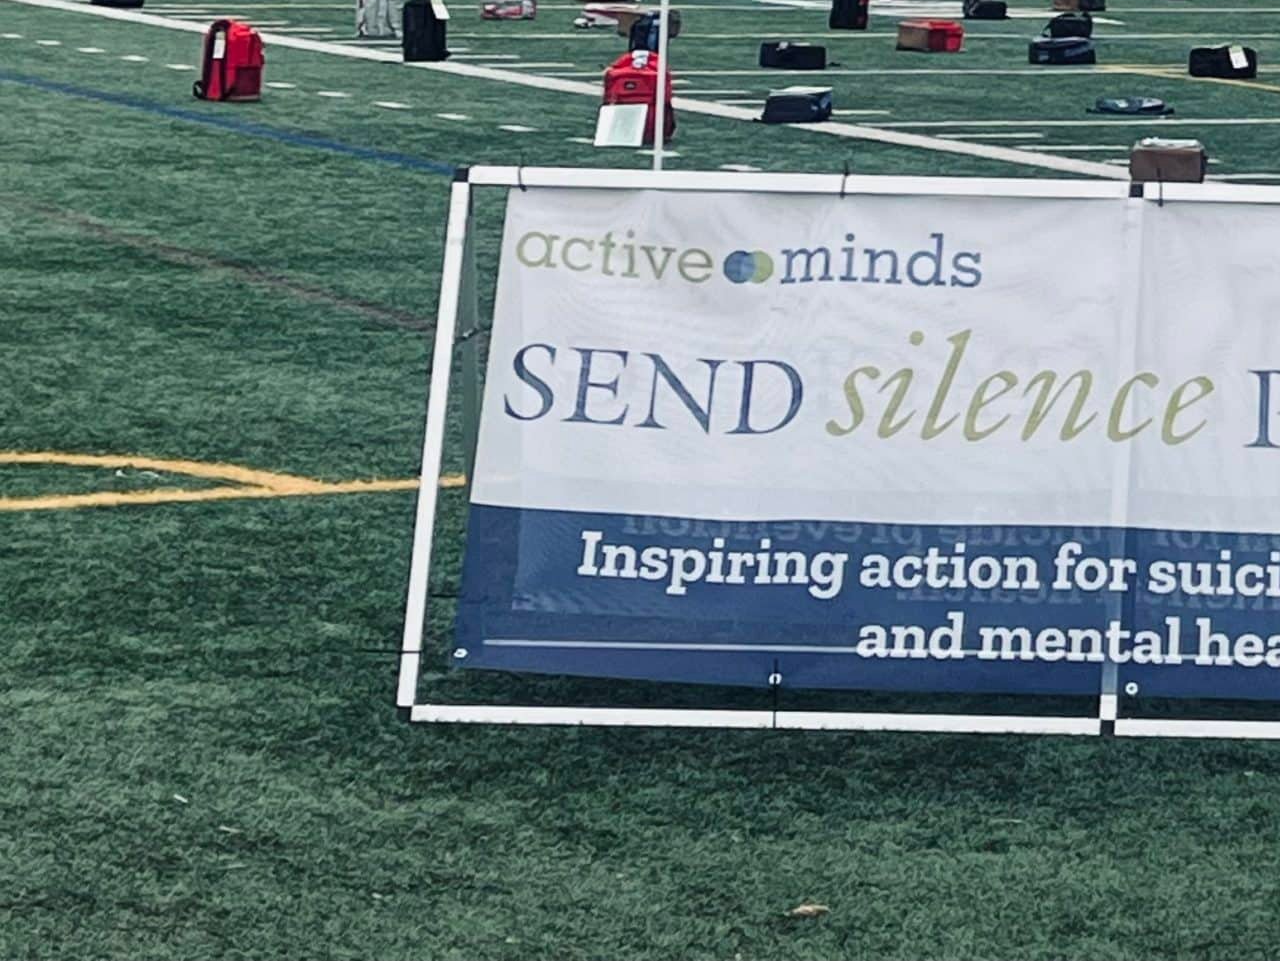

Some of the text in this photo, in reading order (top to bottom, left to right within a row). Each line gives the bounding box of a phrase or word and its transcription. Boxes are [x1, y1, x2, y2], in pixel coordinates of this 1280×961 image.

[516, 229, 983, 289] active minds
[503, 343, 804, 435] SEND
[825, 329, 1215, 445] silence
[577, 530, 849, 598] Inspiring
[859, 543, 1040, 591] action
[1053, 541, 1137, 592] for
[856, 611, 965, 659] and
[977, 616, 1182, 665] mental
